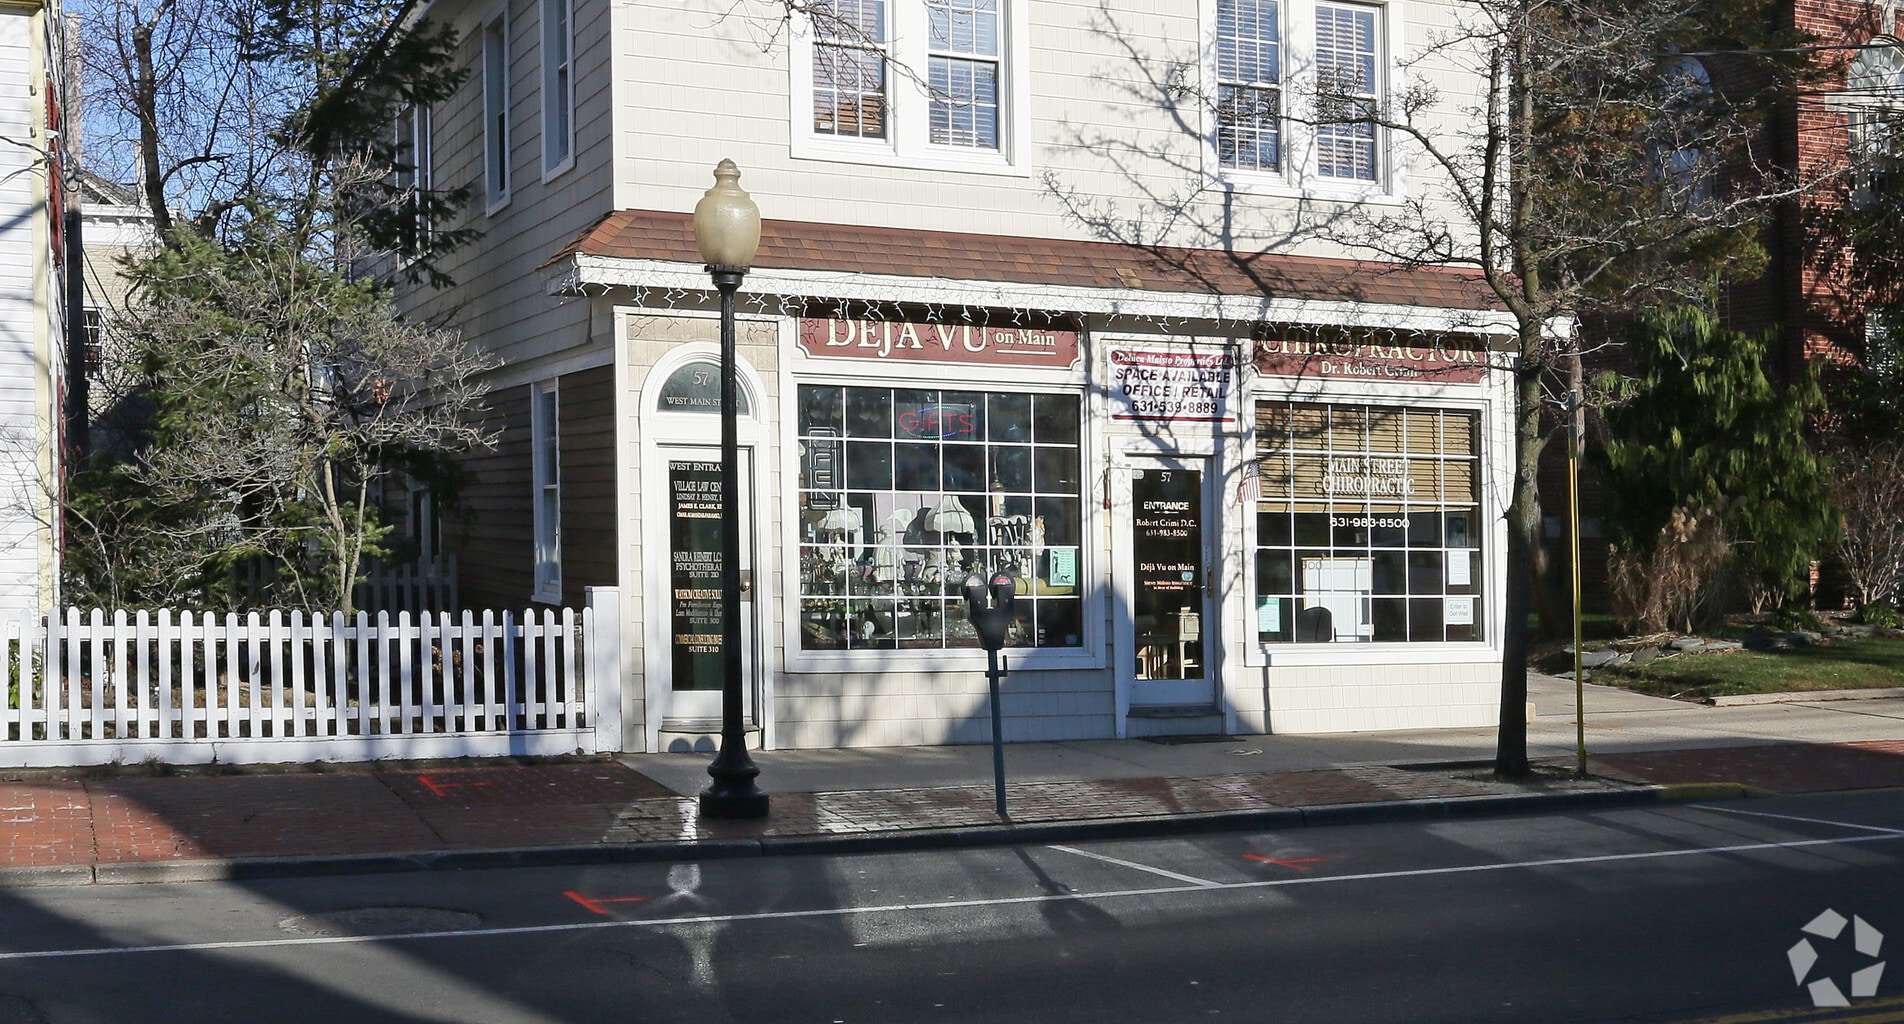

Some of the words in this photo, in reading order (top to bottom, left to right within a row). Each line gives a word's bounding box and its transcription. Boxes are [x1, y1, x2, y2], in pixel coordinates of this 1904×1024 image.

[826, 313, 923, 358] DEJA
[933, 318, 988, 353] VU
[995, 332, 1014, 345] on
[1018, 329, 1056, 347] Main
[1261, 329, 1479, 364] CHIROPRACTOR
[1146, 354, 1172, 366] Maisto
[1174, 356, 1214, 368] Proprties
[1115, 367, 1158, 382] SPACE
[1161, 369, 1231, 384] AVAILABLE
[1321, 360, 1340, 375] Dr.
[1344, 362, 1382, 377] Robert
[692, 370, 710, 387] 57
[1123, 384, 1171, 397] OFFICE
[1182, 386, 1226, 399] RETAIL
[666, 396, 689, 405] WEST
[690, 397, 712, 407] MAIN
[712, 399, 742, 408] STT
[899, 412, 975, 434] GIFTS
[669, 462, 692, 471] WEST
[693, 463, 722, 472] ENTRA
[1328, 457, 1361, 474] MAIN
[1363, 458, 1411, 475] STREET
[1160, 471, 1172, 483] 57
[673, 480, 697, 492] VILLAGE
[697, 481, 709, 492] LAW
[710, 481, 722, 493] CEN
[1322, 475, 1415, 494] CHIROPRACTIC
[1143, 501, 1190, 511] ENTRANCE
[1136, 518, 1159, 527] Robert
[1159, 518, 1180, 527] Crimi
[1180, 519, 1197, 528] D.C.
[1329, 517, 1410, 529] 631-983-8500
[1156, 563, 1167, 571] Vu
[1177, 563, 1195, 571] Main
[688, 645, 708, 653] SUITE
